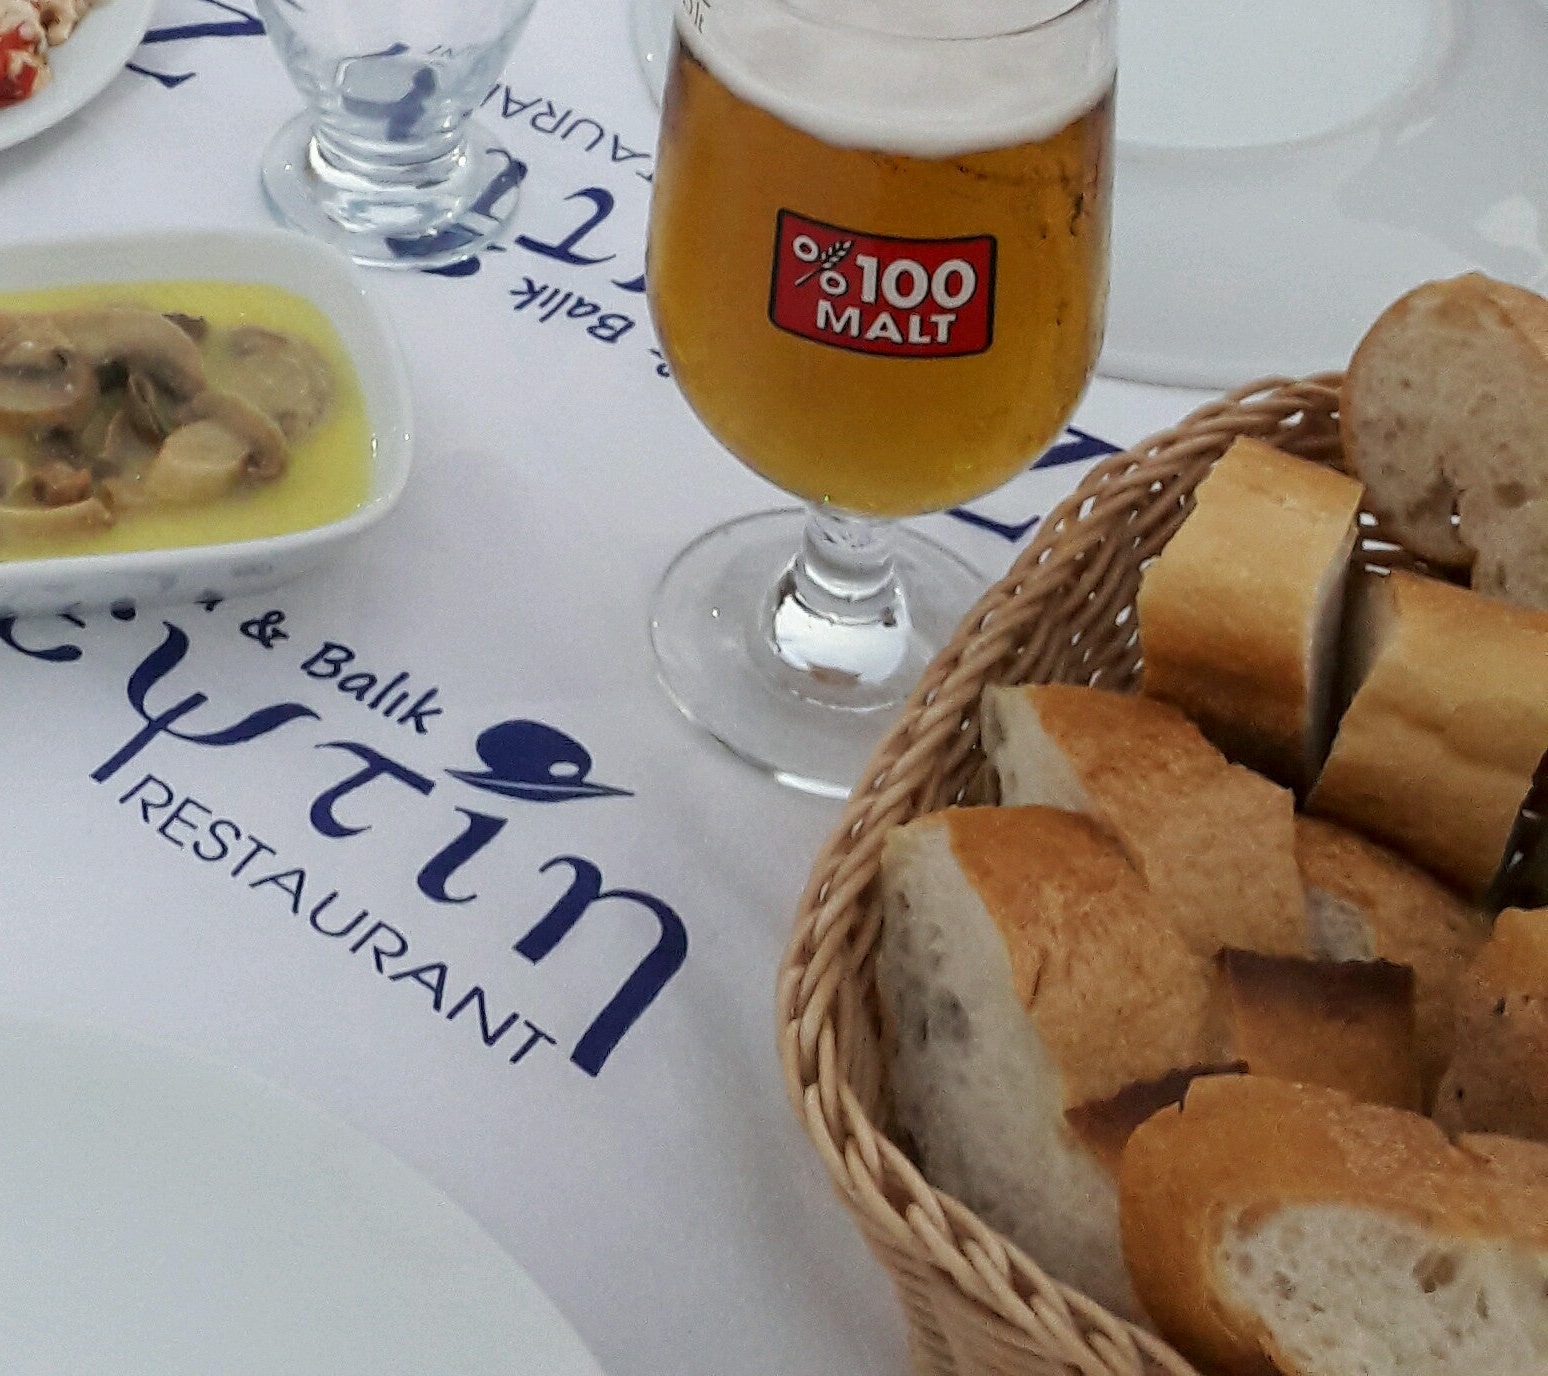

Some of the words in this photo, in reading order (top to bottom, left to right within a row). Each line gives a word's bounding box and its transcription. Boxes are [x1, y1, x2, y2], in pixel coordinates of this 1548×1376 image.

[792, 234, 978, 310] %100
[508, 276, 636, 347] Balık
[815, 298, 958, 346] MALT
[239, 609, 289, 650] &
[300, 640, 444, 736] Balık
[119, 774, 558, 1066] RESTAURANT
